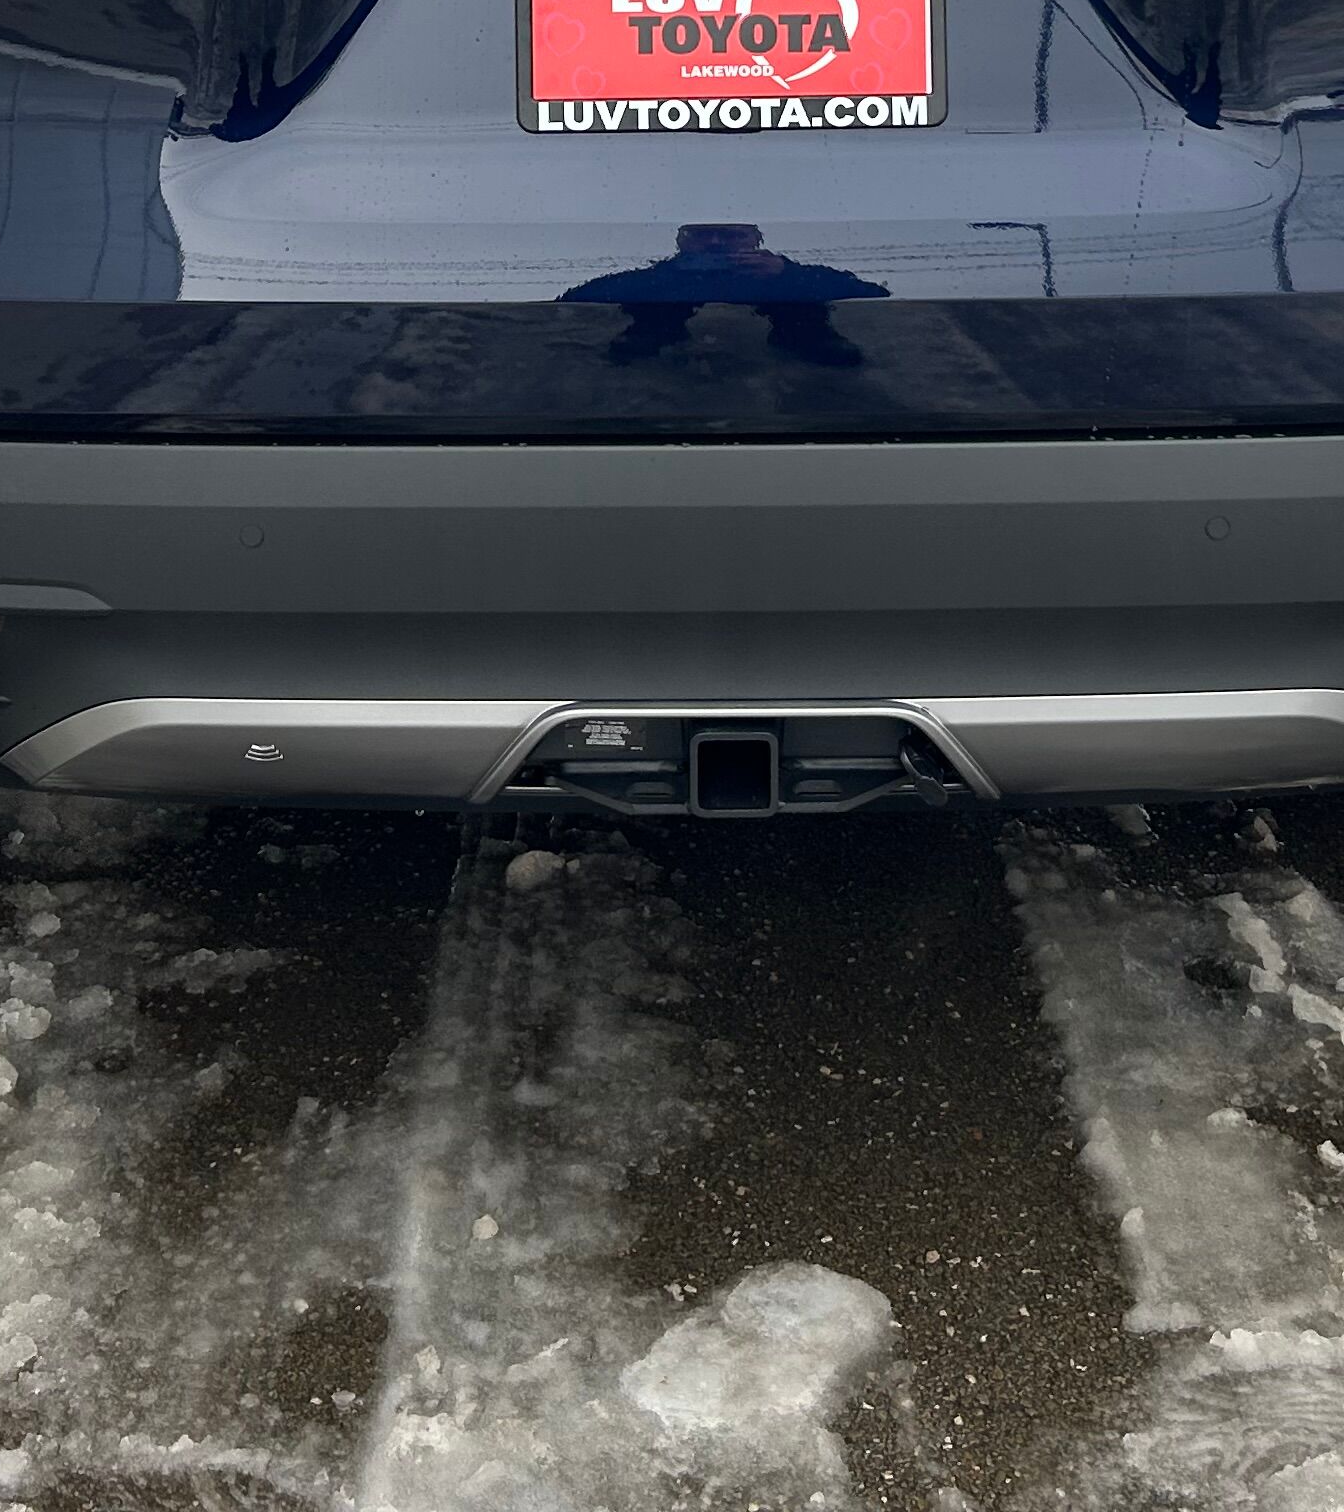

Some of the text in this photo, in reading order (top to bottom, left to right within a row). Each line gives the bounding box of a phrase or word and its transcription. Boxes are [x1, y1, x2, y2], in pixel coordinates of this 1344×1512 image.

[629, 13, 851, 55] TOYOTA
[680, 64, 774, 78] LAKEWOOD
[537, 95, 929, 131] LUVTOYOTA.COM
